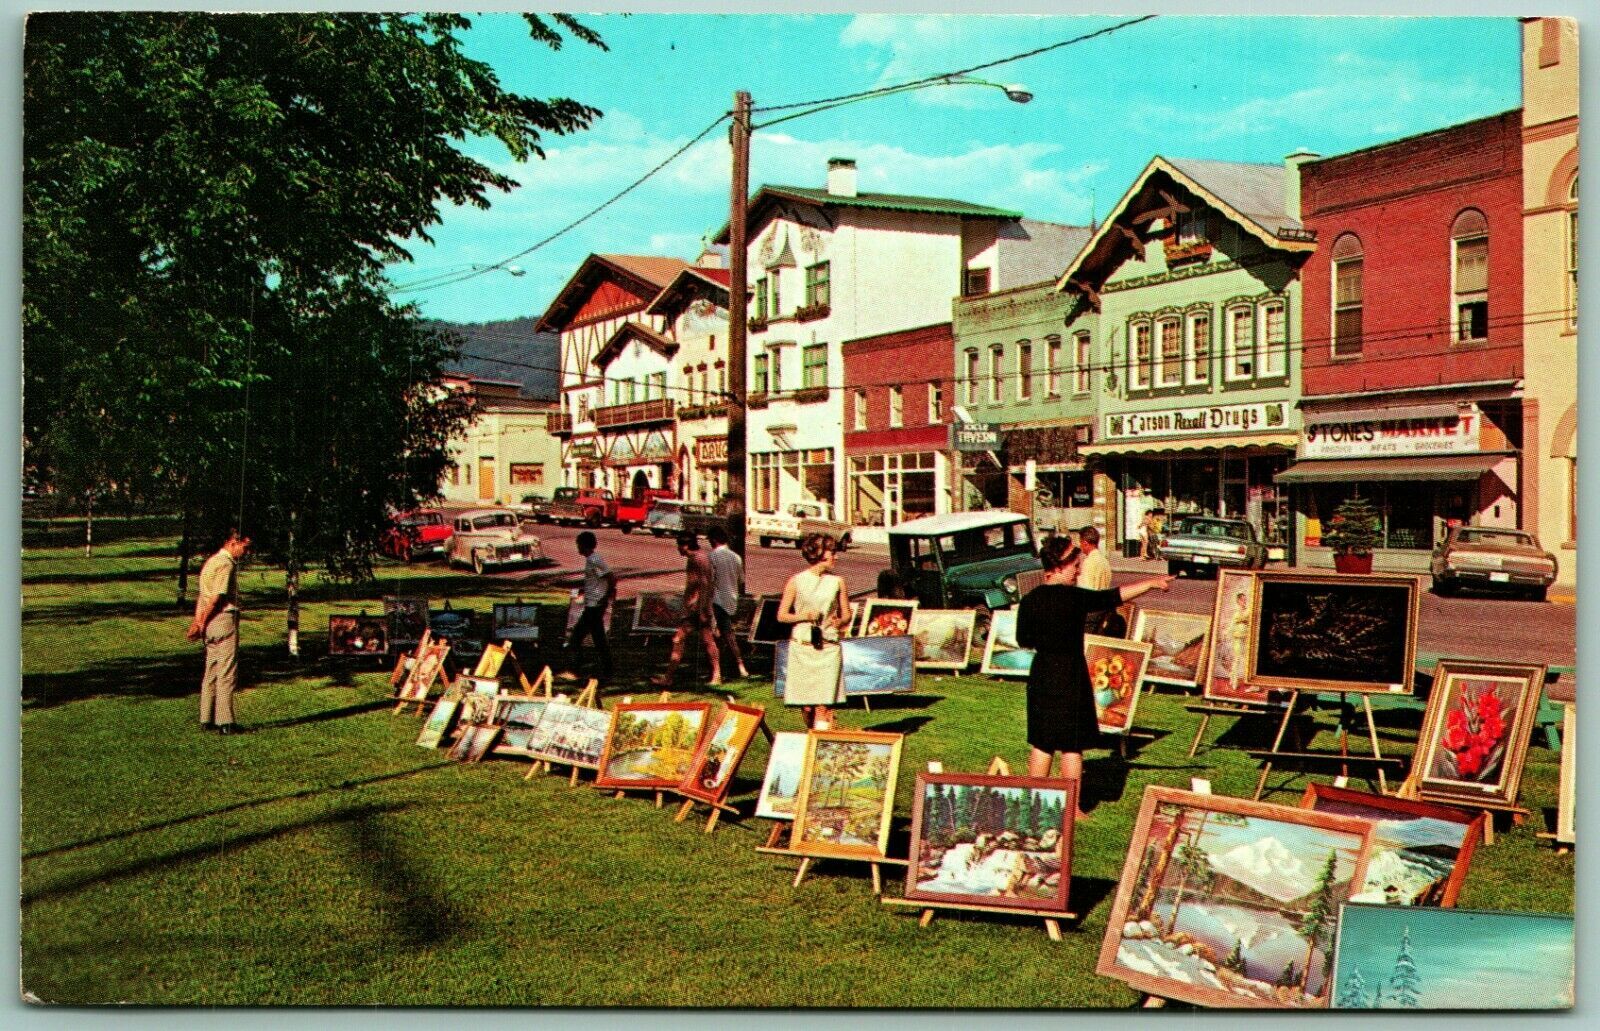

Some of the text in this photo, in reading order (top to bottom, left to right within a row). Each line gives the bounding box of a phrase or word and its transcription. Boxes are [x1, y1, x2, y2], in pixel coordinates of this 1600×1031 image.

[1127, 408, 1258, 435] Larson Rexall Drugs
[1306, 414, 1474, 443] STONES MARKET
